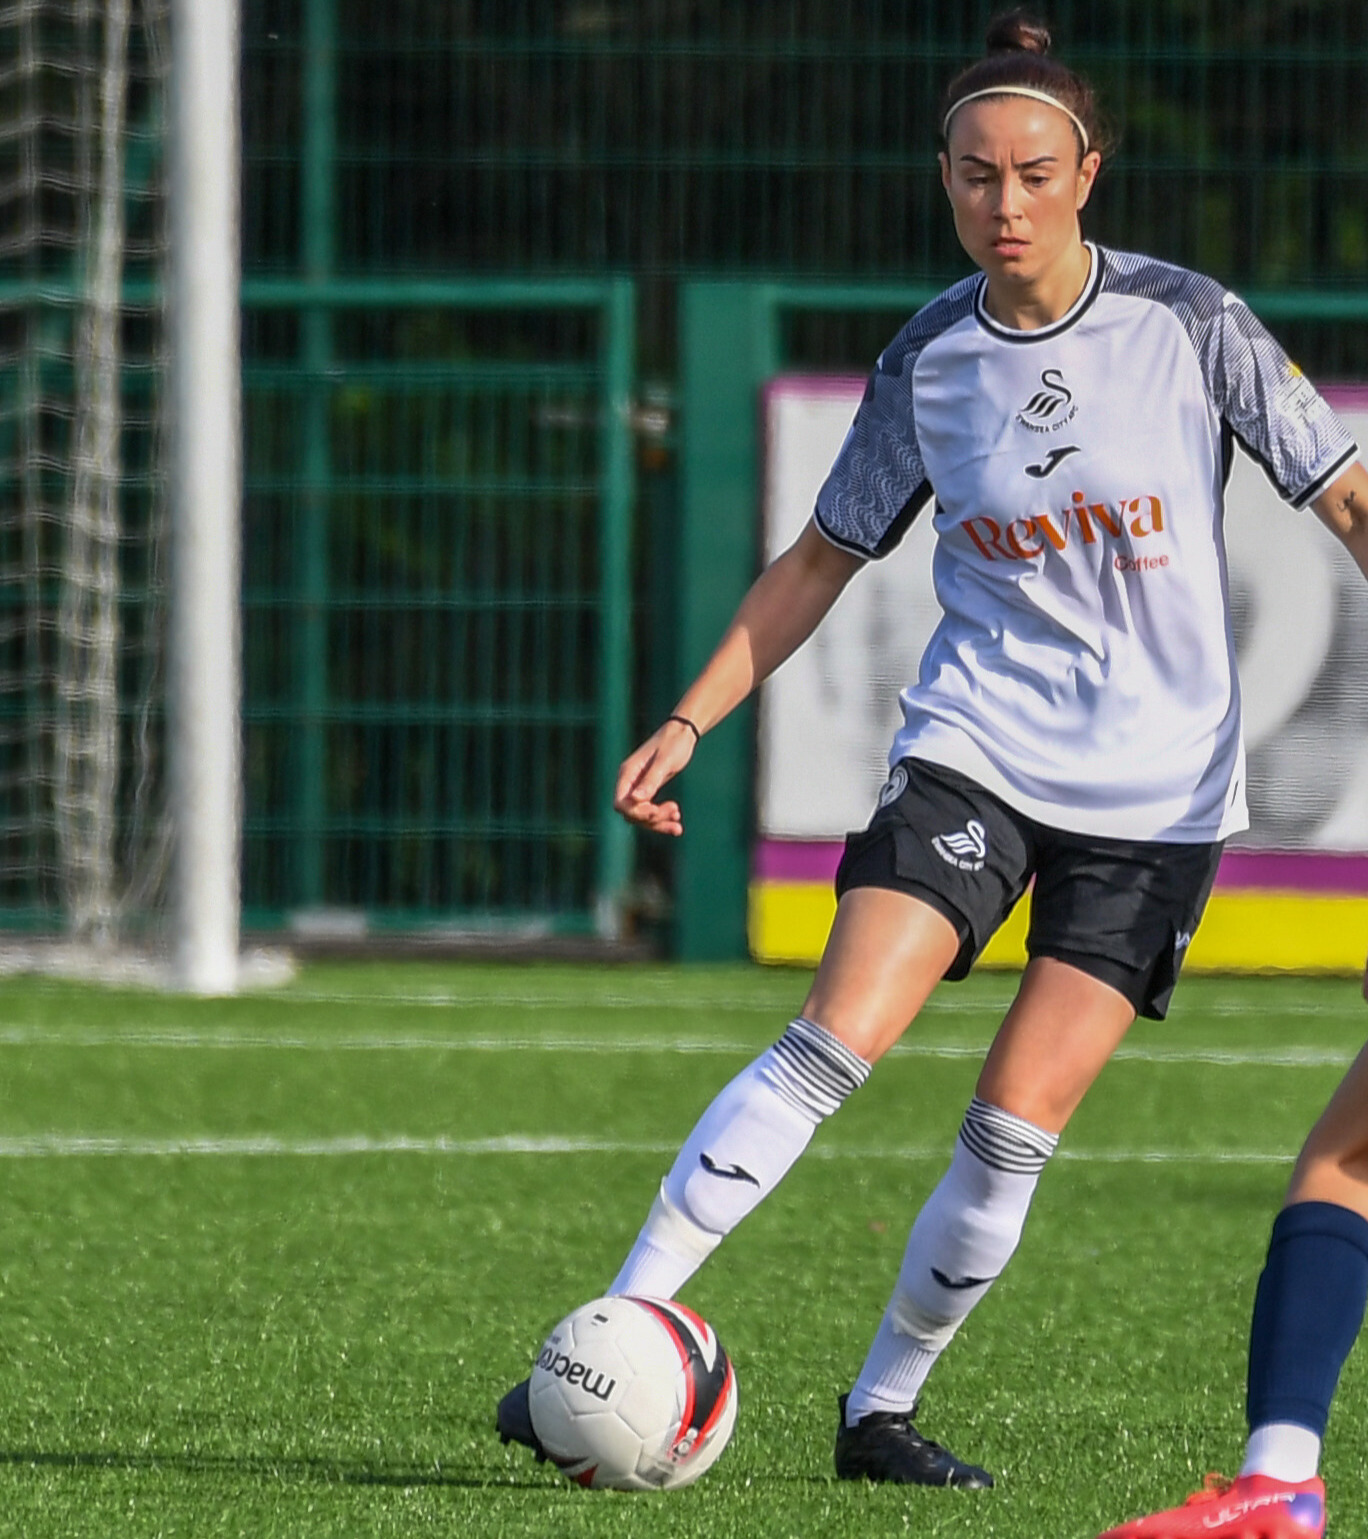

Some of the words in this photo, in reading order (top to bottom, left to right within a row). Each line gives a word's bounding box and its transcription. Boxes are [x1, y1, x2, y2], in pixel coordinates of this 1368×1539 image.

[1052, 417, 1068, 431] CITY
[960, 491, 1164, 561] Reviva
[1114, 554, 1169, 572] Coffee
[535, 1347, 616, 1402] macro
